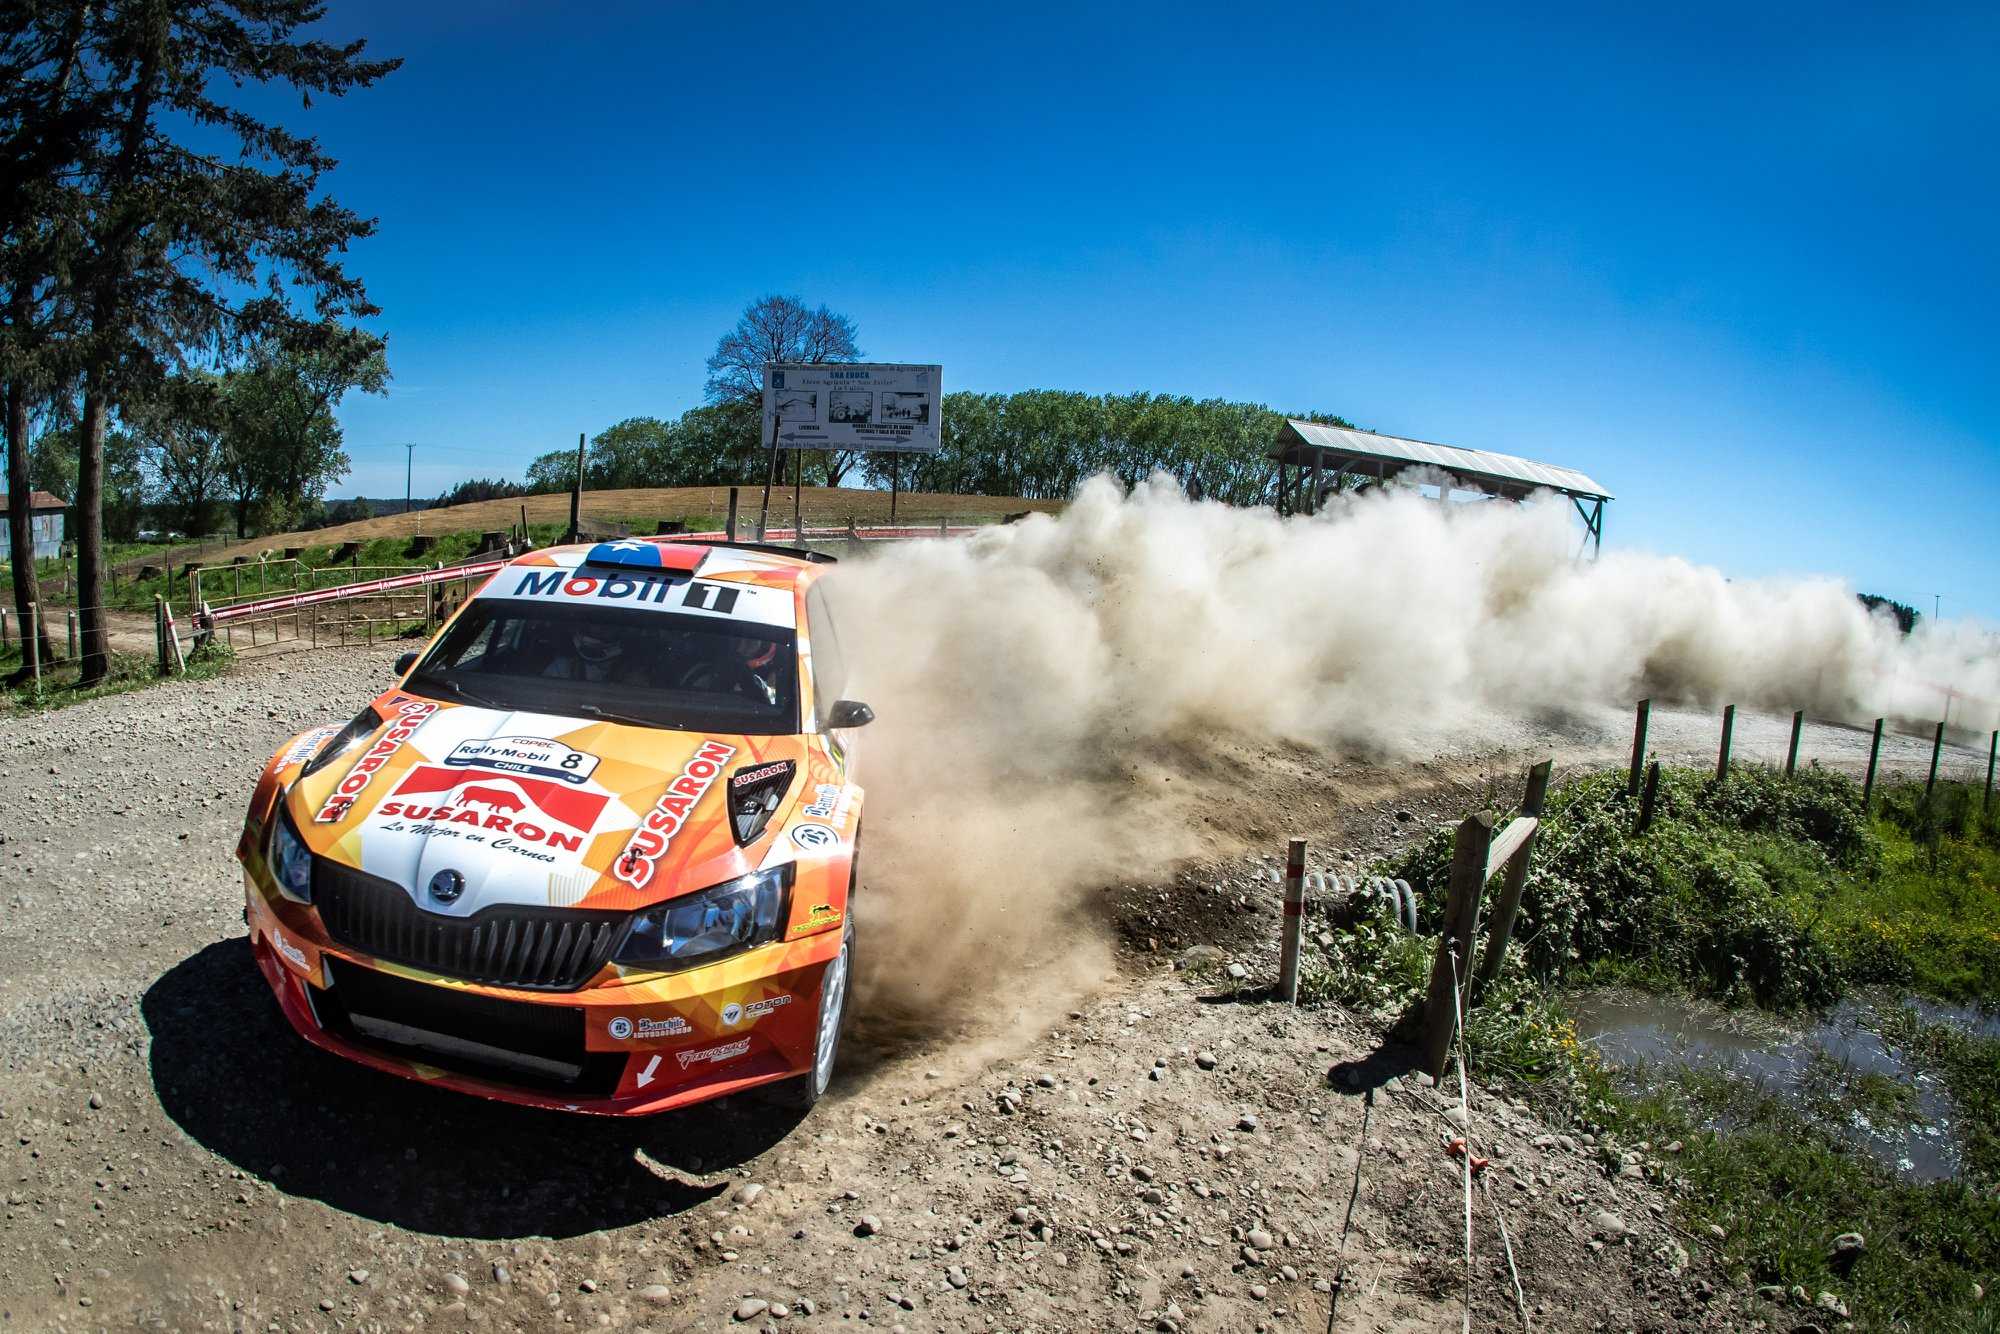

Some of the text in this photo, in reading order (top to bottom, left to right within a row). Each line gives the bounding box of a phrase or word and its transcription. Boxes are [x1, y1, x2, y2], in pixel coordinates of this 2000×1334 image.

[513, 571, 674, 604] Mobil
[318, 703, 438, 821] SUSARON
[493, 762, 532, 772] CHILE
[560, 753, 583, 769] 8
[734, 762, 788, 787] SUSARON
[378, 802, 584, 852] SUSARON
[618, 742, 735, 885] SUSARON
[380, 822, 405, 832] Lo
[466, 832, 485, 842] en
[491, 838, 556, 863] Carnes
[745, 995, 792, 1012] FOTON
